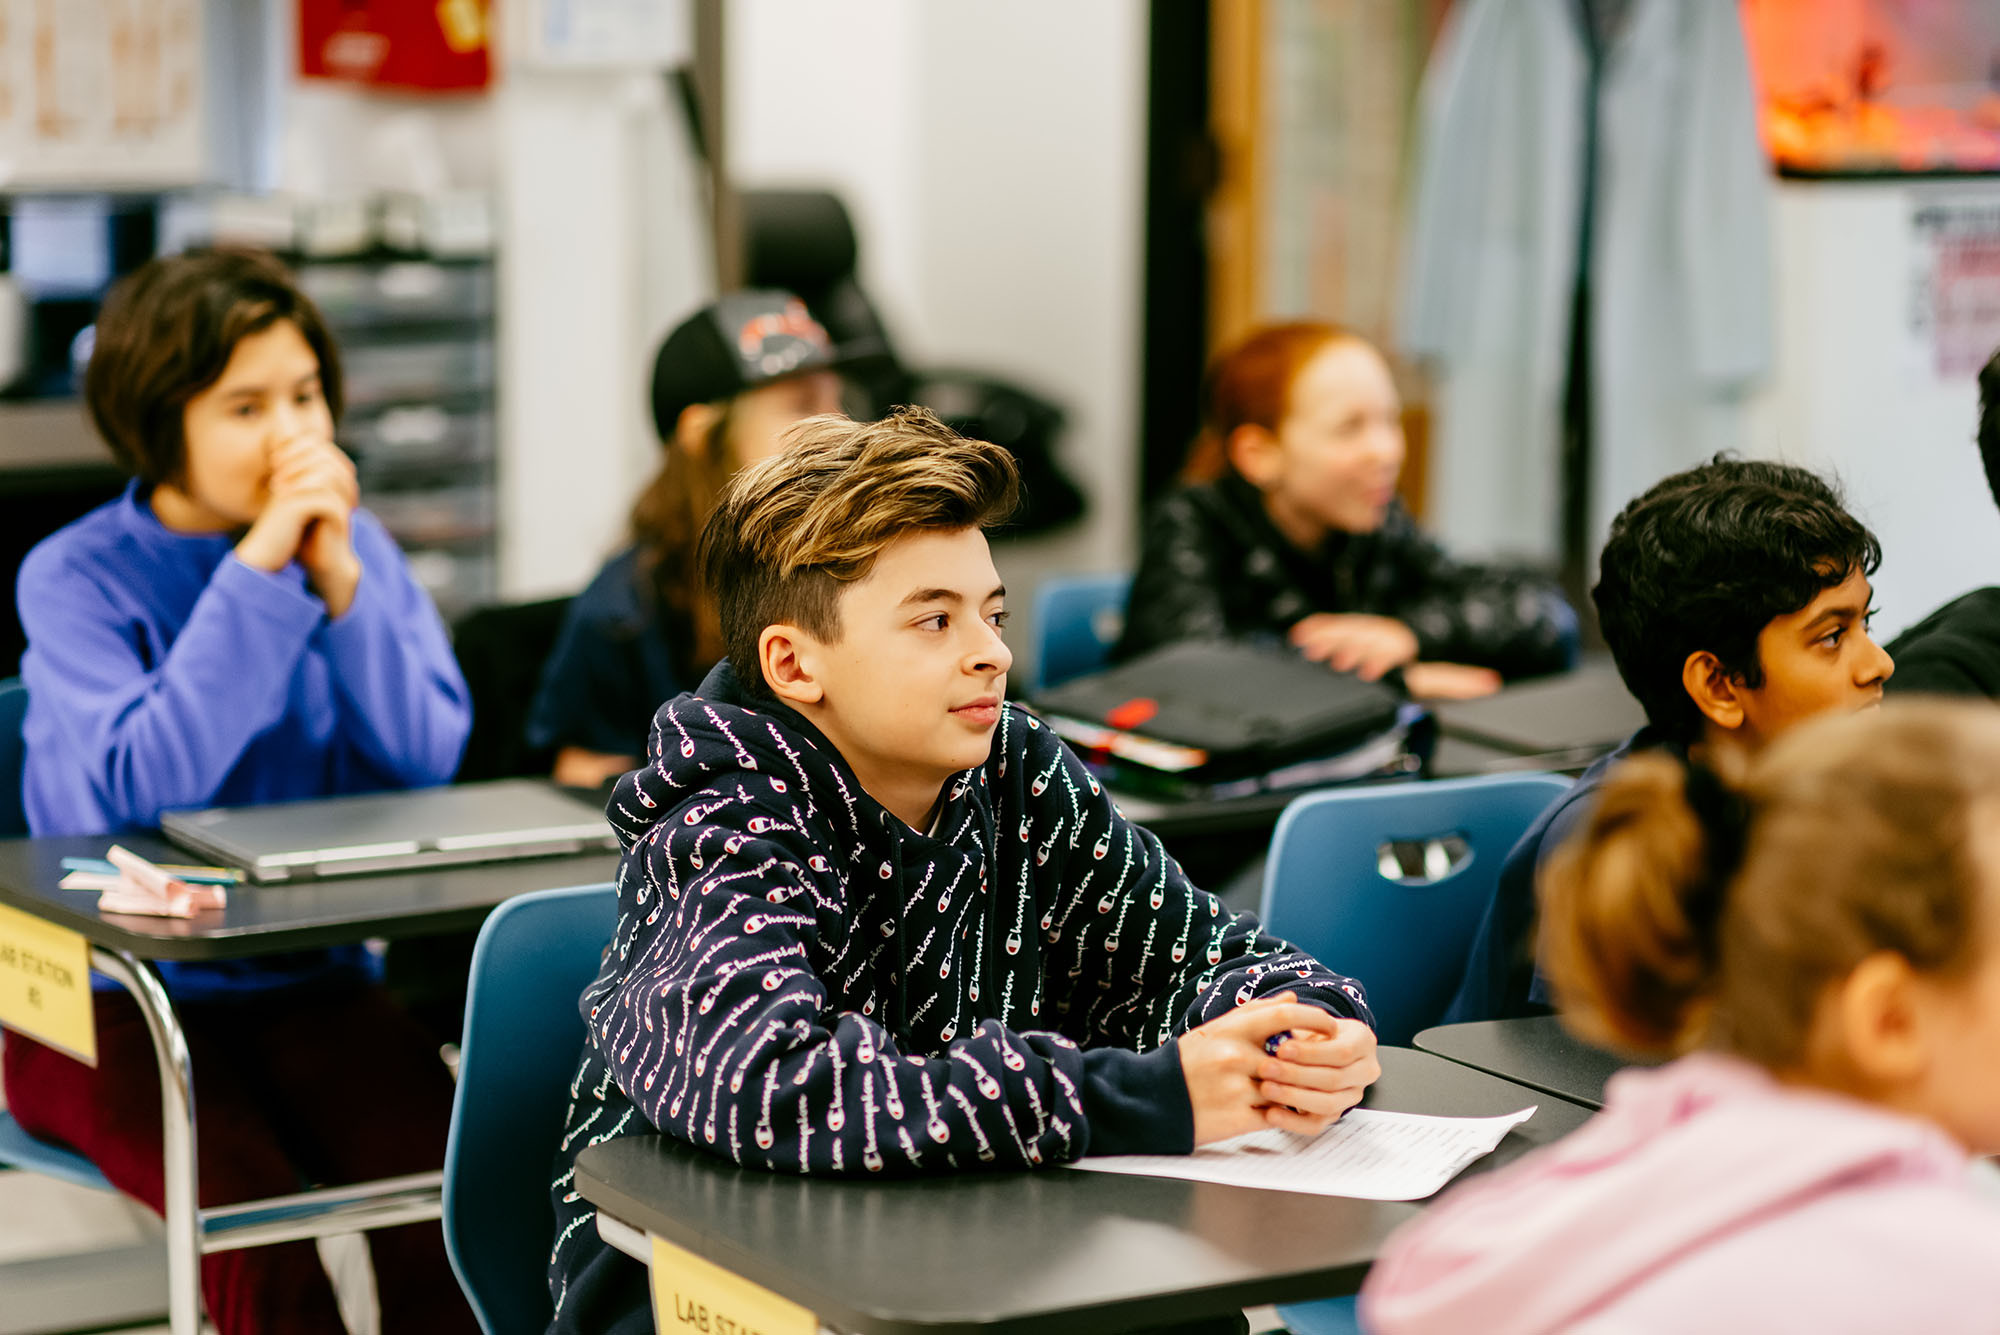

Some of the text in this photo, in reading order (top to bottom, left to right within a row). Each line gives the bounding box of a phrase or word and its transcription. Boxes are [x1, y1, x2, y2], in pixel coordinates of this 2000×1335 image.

[703, 705, 758, 771] Champion
[766, 722, 810, 793] hampion
[829, 763, 859, 832] hampion
[1005, 857, 1032, 956] Champion
[1047, 868, 1094, 944] Champion
[1097, 828, 1135, 914] Champion
[644, 1004, 669, 1093] Champion
[694, 994, 760, 1078] Champion
[704, 1046, 736, 1144] Champion
[754, 1057, 781, 1150] Champion
[860, 1070, 884, 1173] Champion
[674, 1292, 710, 1334] LAB
